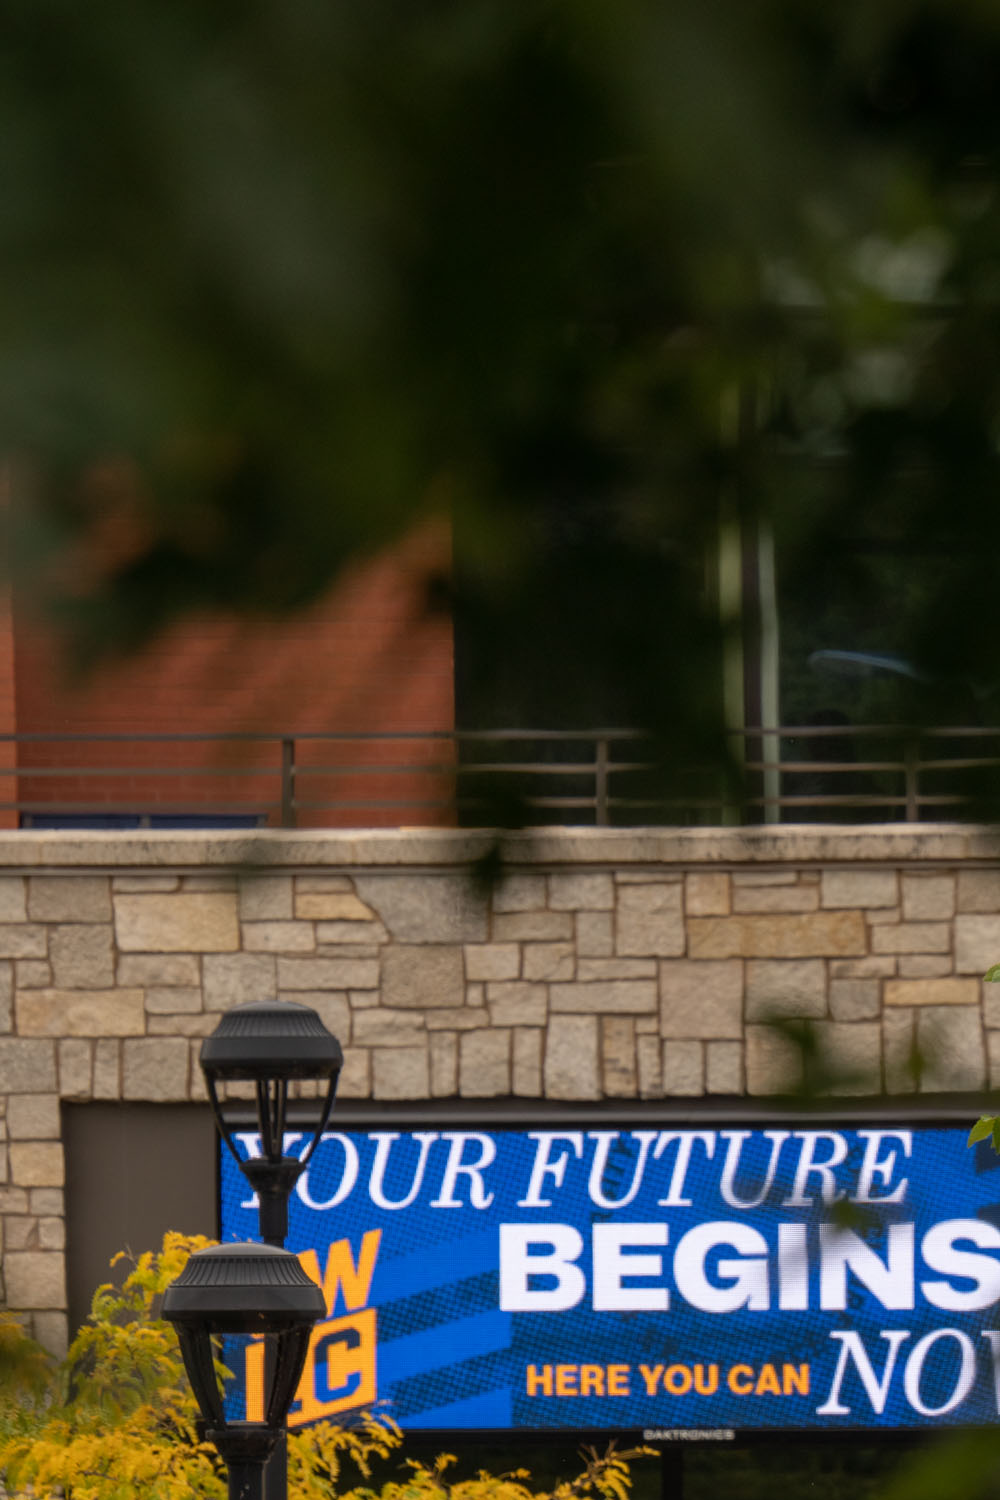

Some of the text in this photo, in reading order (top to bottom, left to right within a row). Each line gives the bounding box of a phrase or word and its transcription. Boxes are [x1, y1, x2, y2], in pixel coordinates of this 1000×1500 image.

[517, 1131, 912, 1209] FUTURE
[526, 1364, 810, 1396] HERE YOU CAN
[643, 1429, 735, 1440] DAKTRONICS
